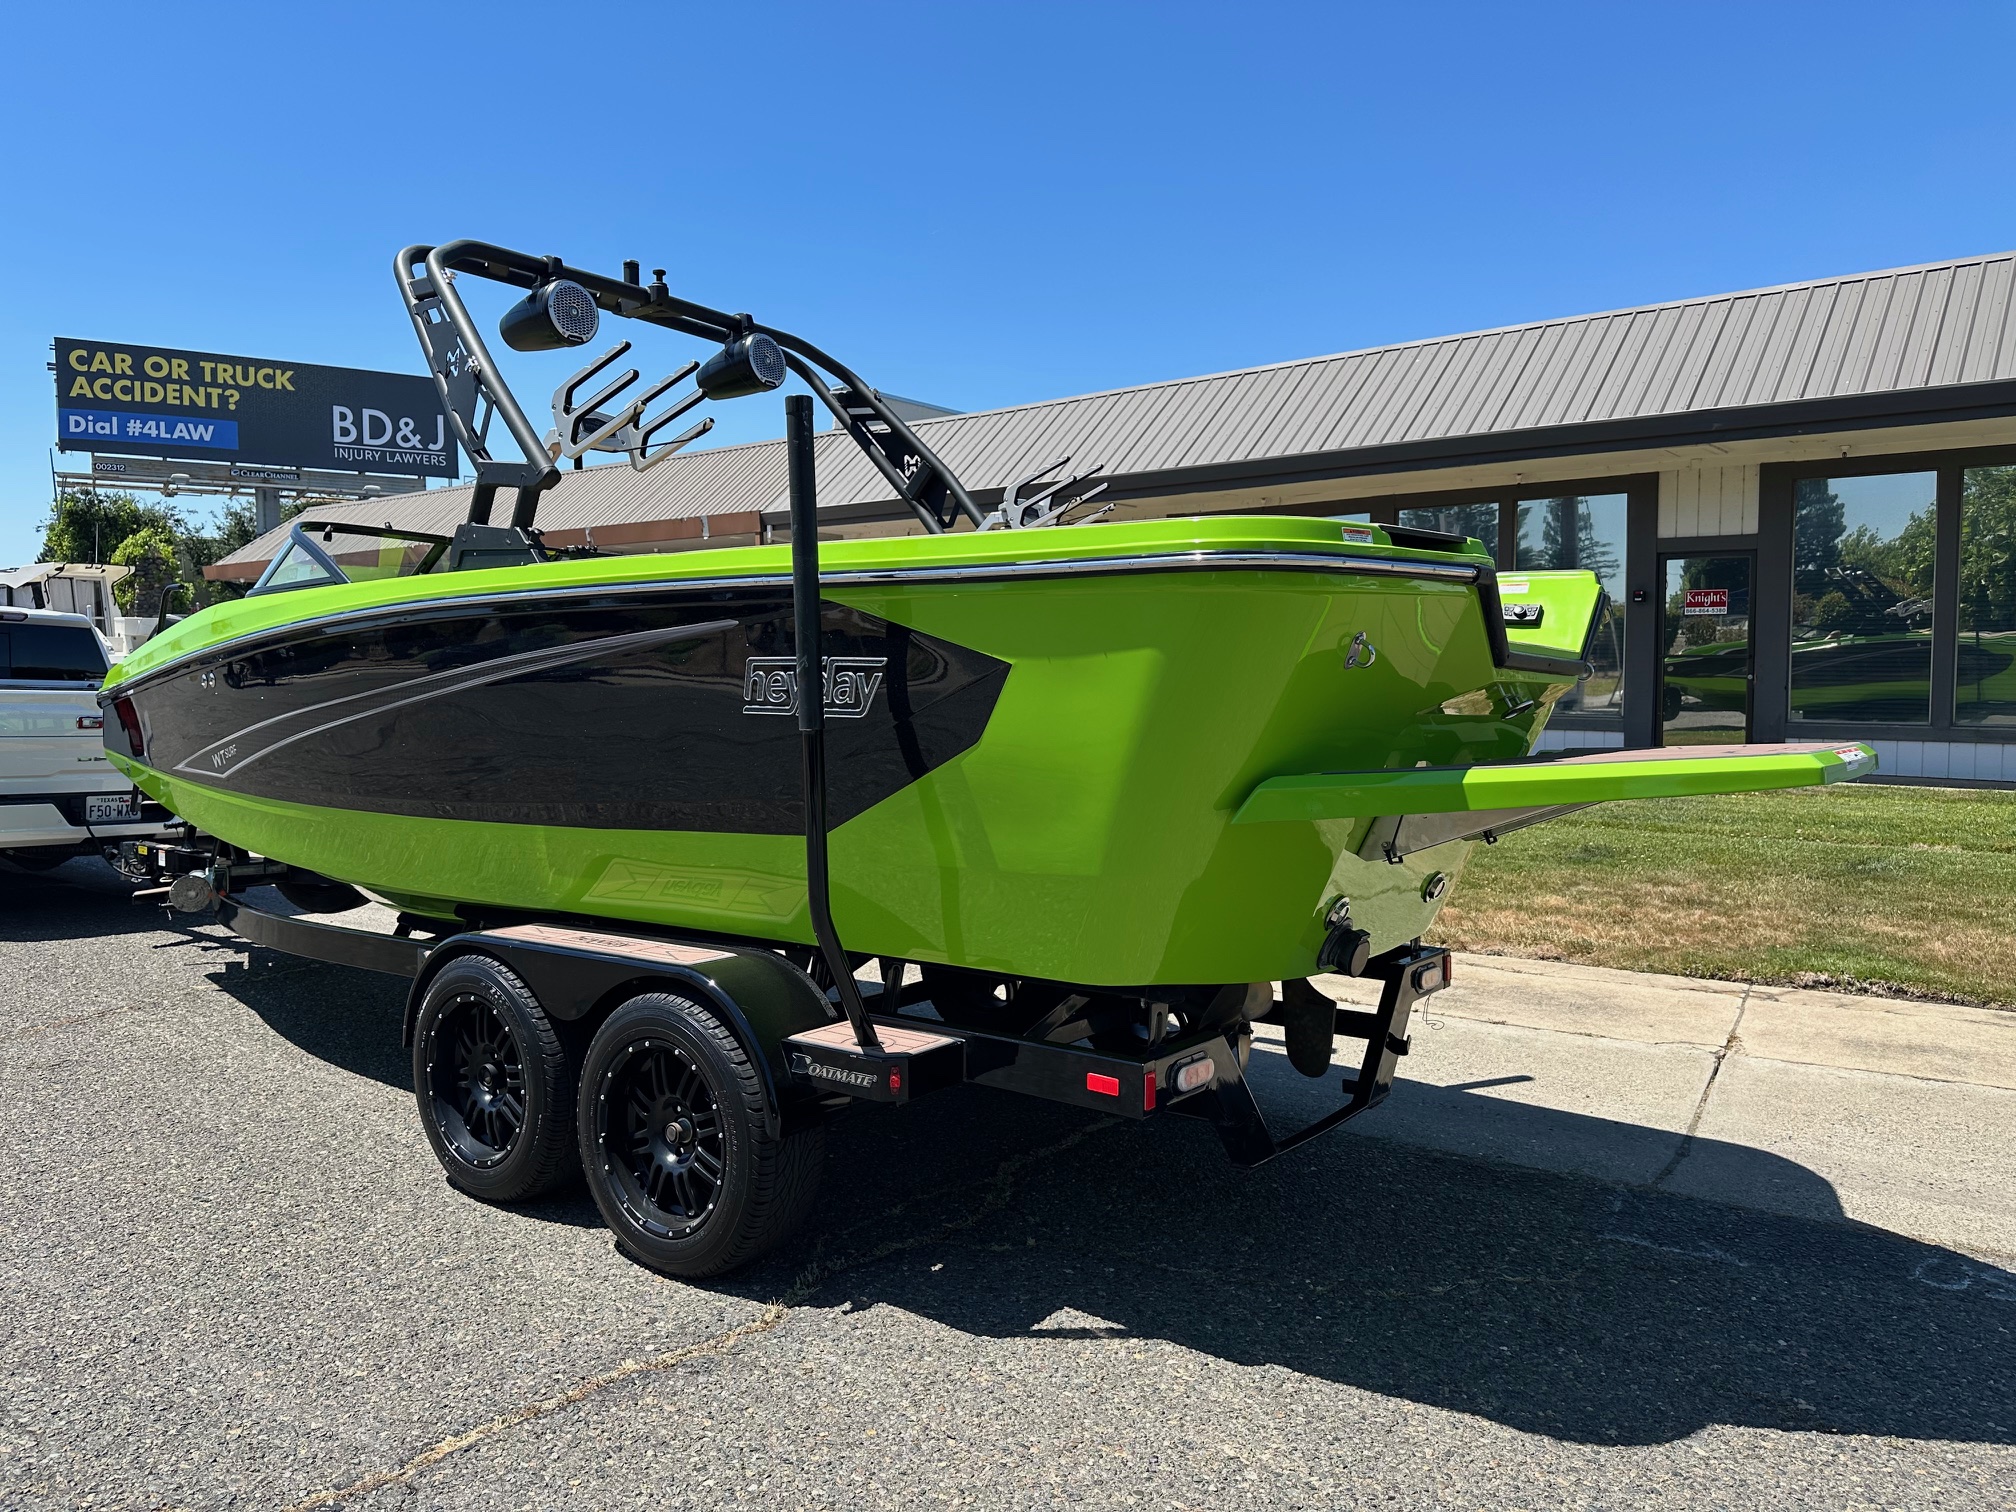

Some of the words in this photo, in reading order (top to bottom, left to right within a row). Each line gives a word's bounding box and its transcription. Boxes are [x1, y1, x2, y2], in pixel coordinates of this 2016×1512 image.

[69, 349, 134, 376] CAR
[143, 355, 190, 380] OR
[200, 361, 295, 391] TRUCK
[69, 376, 240, 410] ACCIDENT?
[69, 415, 118, 435] Dial
[126, 419, 214, 442] #4LAW
[332, 405, 445, 451] BD&J
[95, 463, 125, 472] 002312
[334, 447, 380, 461] INJURY
[386, 452, 447, 466] LAWYERS
[1686, 592, 1727, 606] Knight's
